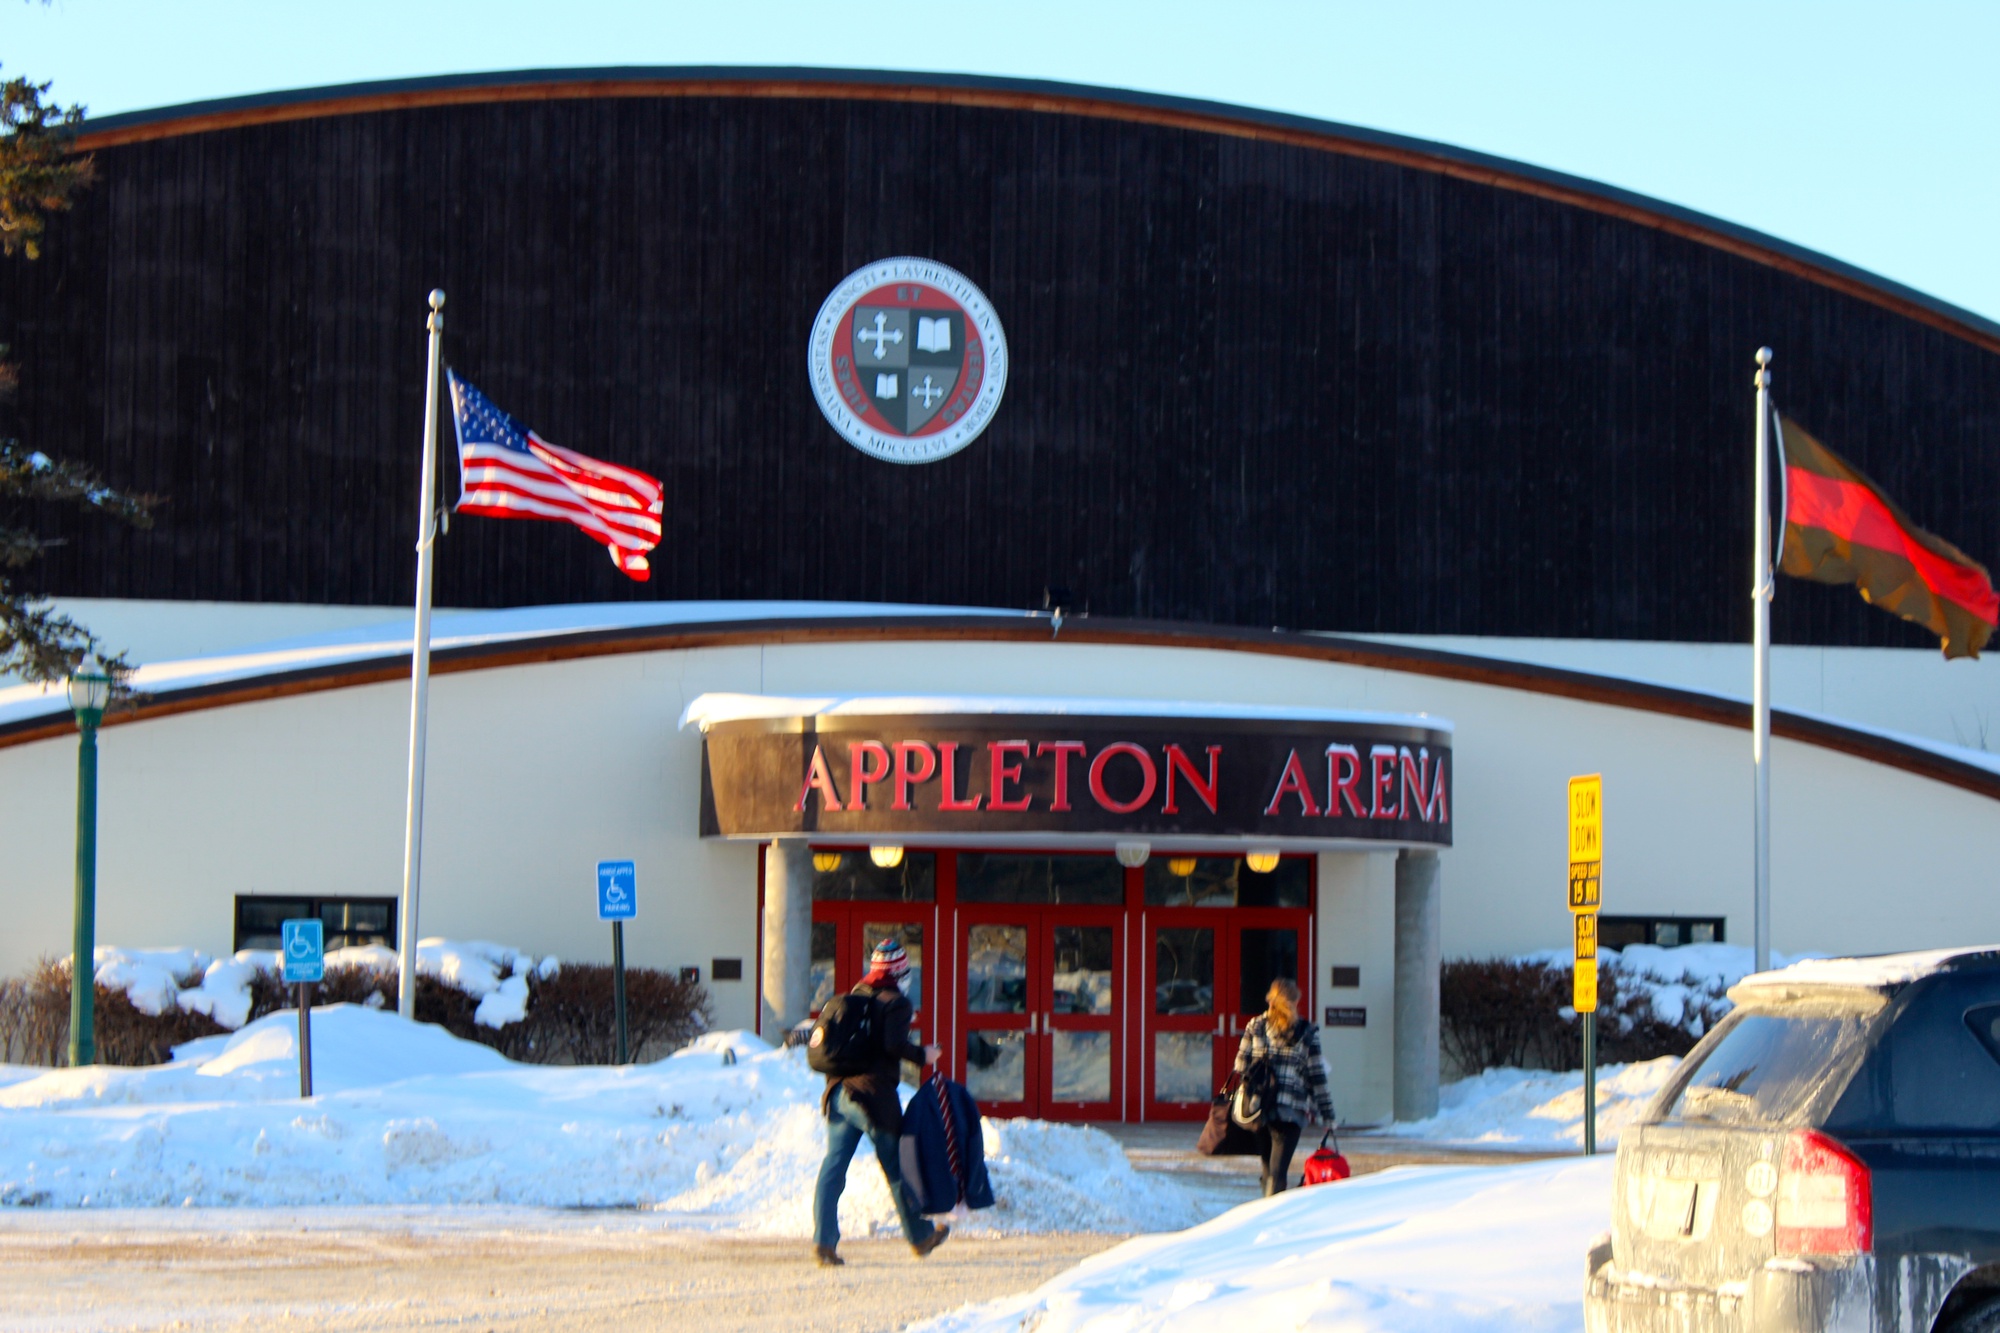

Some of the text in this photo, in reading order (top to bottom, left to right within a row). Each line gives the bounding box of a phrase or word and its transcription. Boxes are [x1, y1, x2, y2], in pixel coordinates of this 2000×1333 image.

[896, 285, 924, 303] ET
[978, 310, 995, 331] IN
[835, 354, 870, 416] FIDES
[941, 337, 984, 424] VERITAS
[792, 739, 1449, 824] APPLETON ARENA
[1575, 789, 1597, 819] SLOW
[1575, 824, 1597, 852] DOWN
[1570, 863, 1588, 880] SPEED
[1573, 879, 1584, 904] 15
[604, 902, 631, 913] PARKING
[1578, 914, 1594, 937] SLOW
[1578, 936, 1595, 957] DOWN
